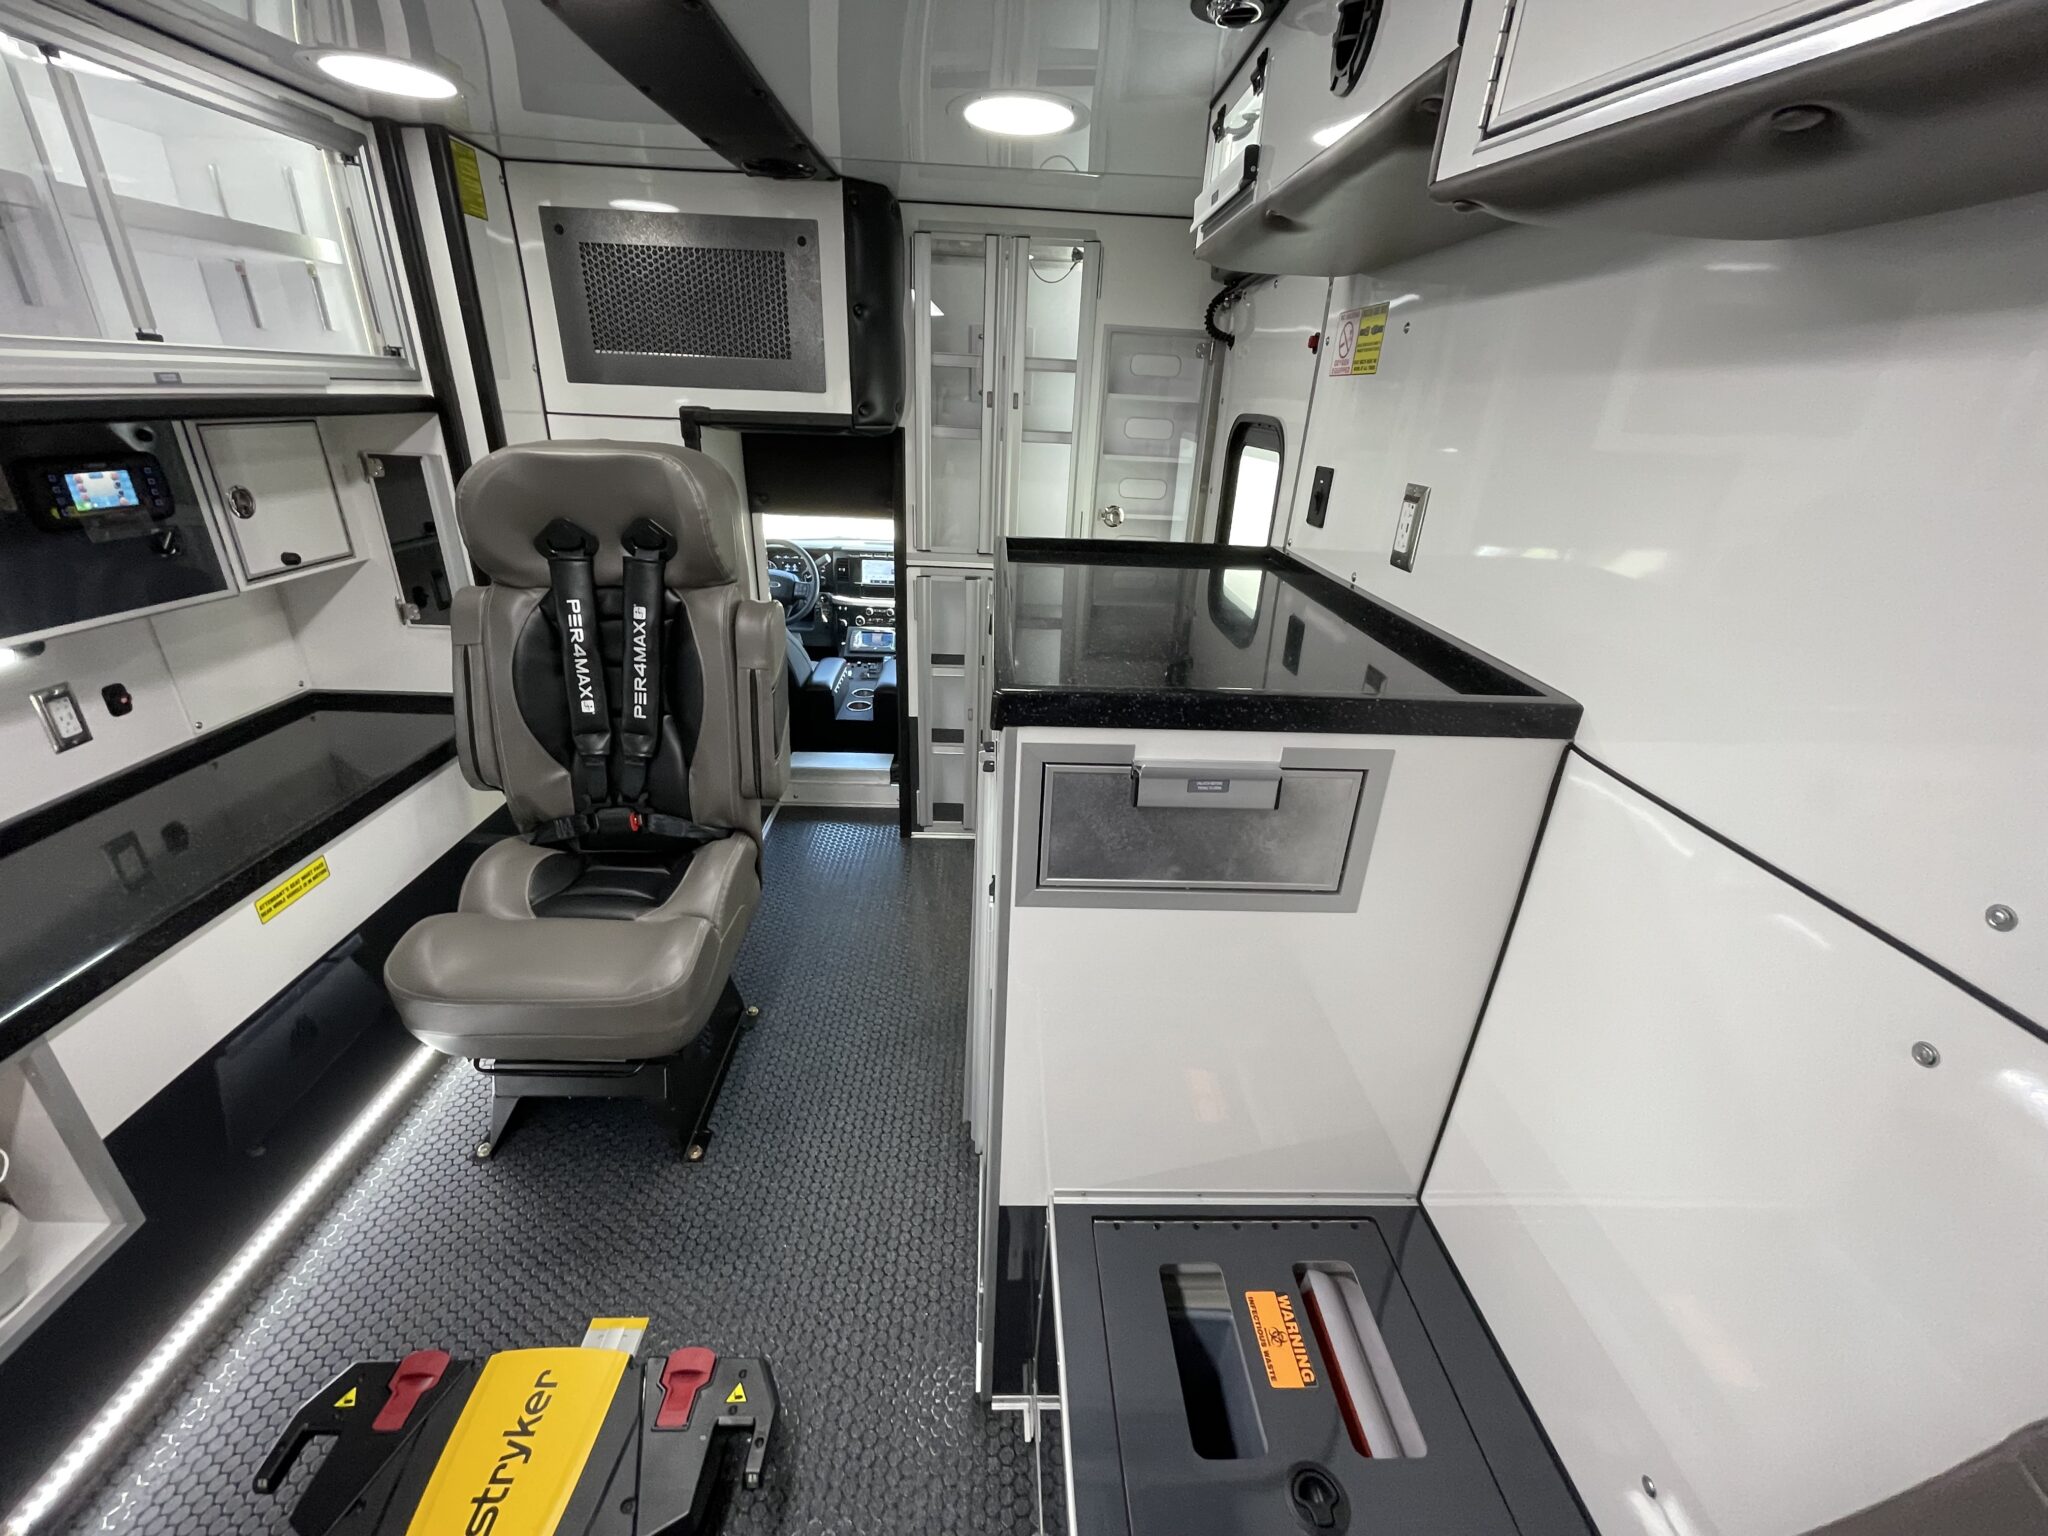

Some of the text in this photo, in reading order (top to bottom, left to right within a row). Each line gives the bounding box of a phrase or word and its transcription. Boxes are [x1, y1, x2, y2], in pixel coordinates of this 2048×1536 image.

[566, 599, 594, 699] PER4MAX
[633, 621, 647, 719] PER4MAX
[1248, 1296, 1277, 1381] INFECTIOUS WASTE
[1277, 1294, 1315, 1383] WARNING
[465, 1369, 558, 1536] stryker
